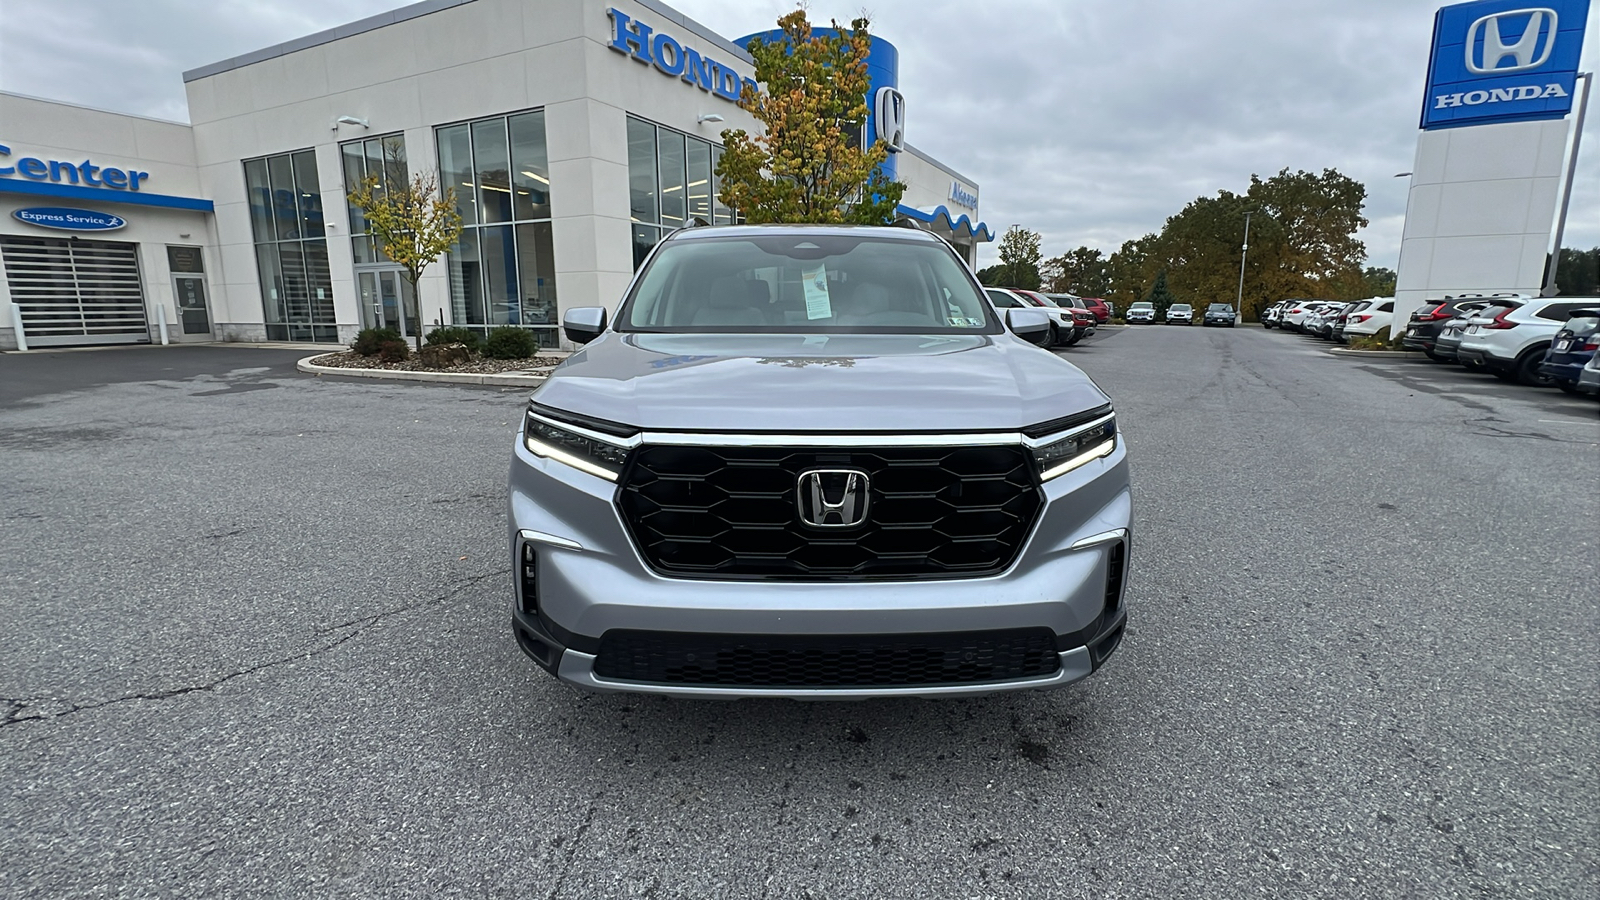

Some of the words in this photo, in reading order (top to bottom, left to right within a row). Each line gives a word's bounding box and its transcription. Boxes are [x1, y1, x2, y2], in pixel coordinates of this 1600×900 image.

[1434, 83, 1568, 109] HONDA
[20, 211, 64, 221] Express
[66, 214, 105, 225] Service
